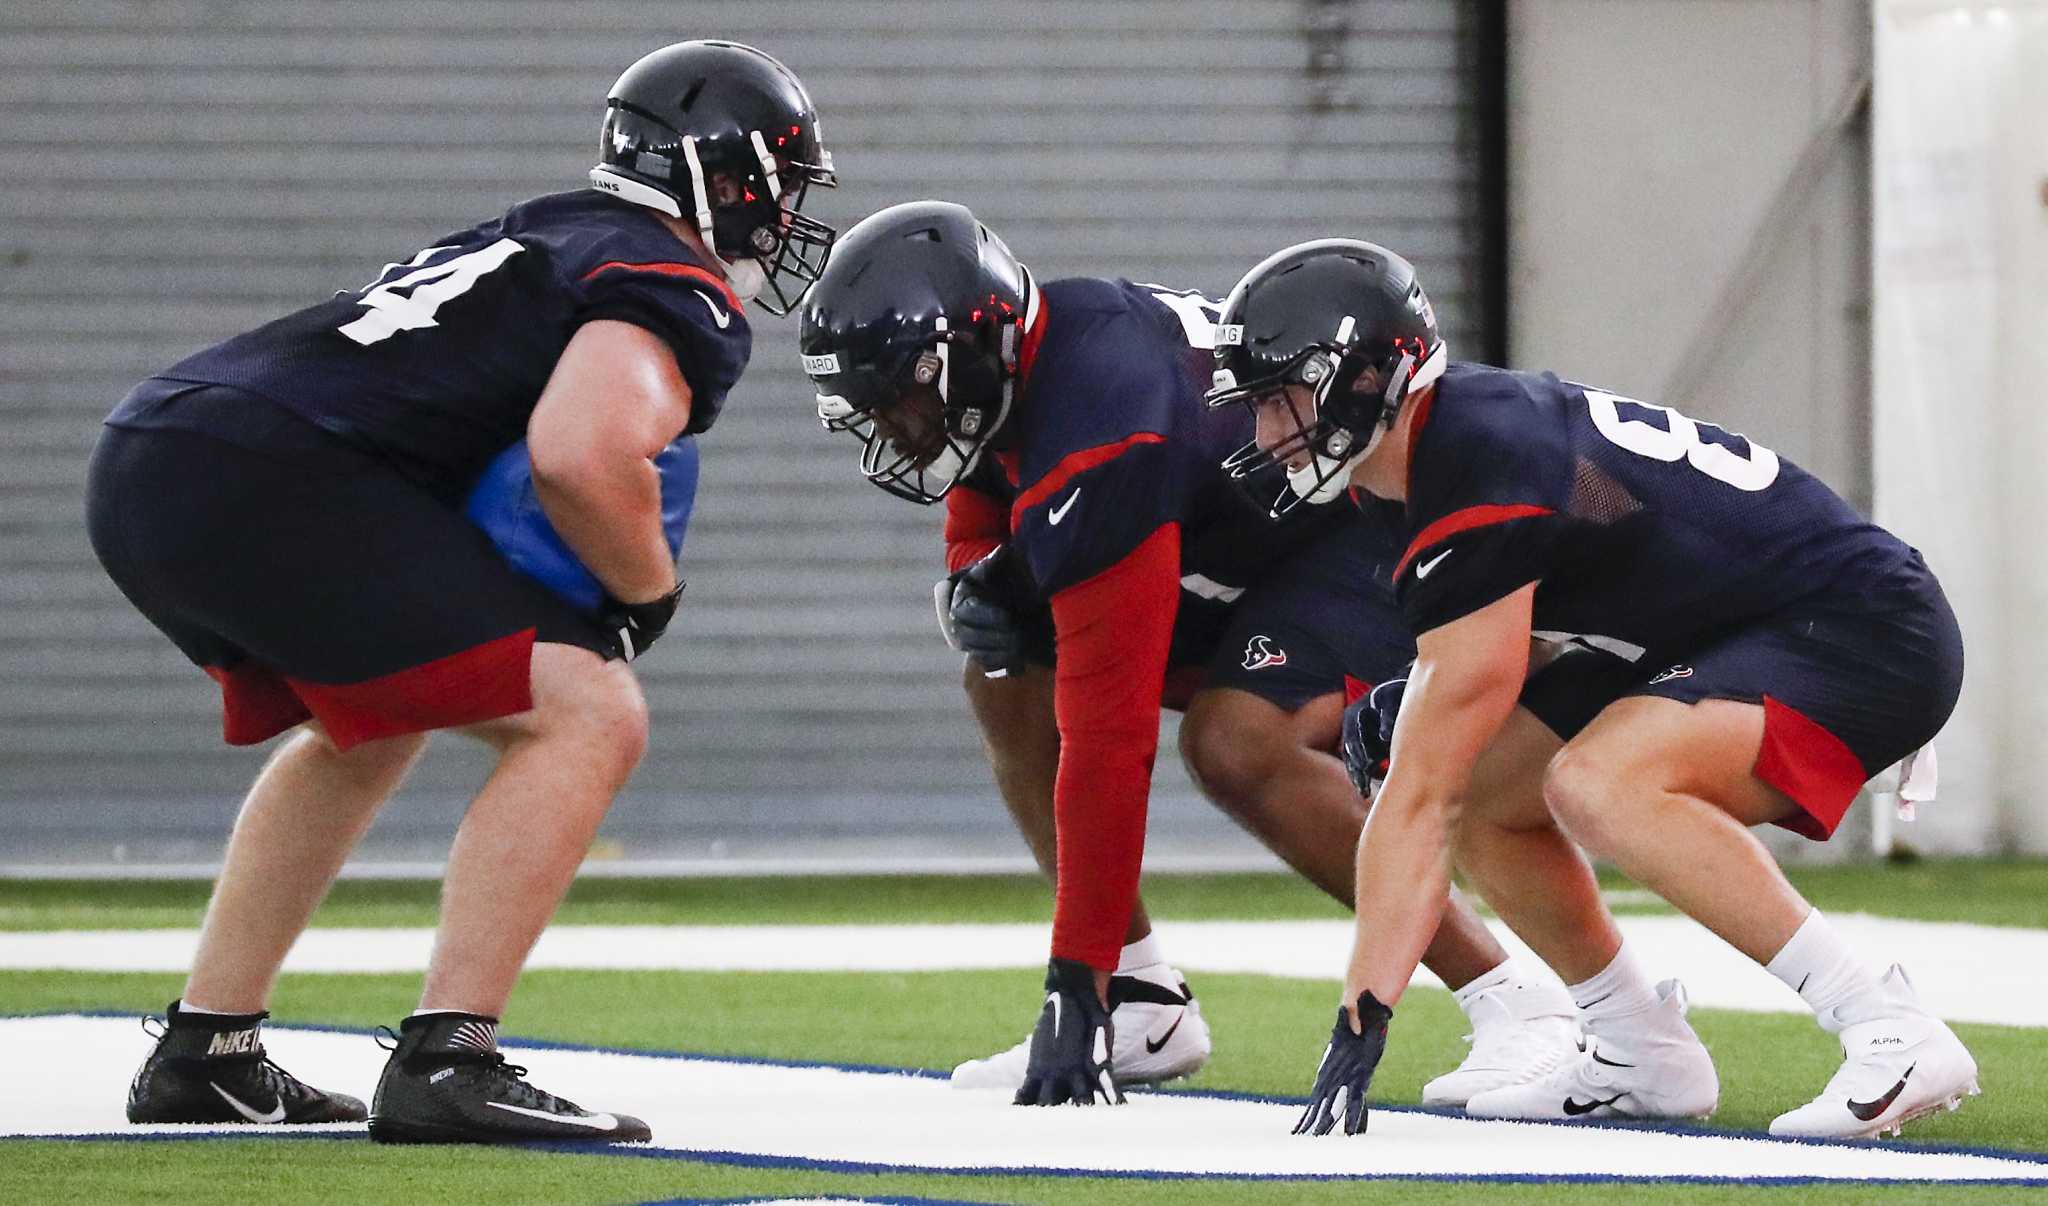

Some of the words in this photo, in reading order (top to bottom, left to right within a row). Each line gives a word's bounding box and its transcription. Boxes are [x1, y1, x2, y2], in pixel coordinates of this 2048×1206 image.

[336, 237, 526, 346] 4
[1582, 388, 1780, 492] 8
[207, 1028, 255, 1055] NIKE
[1870, 1037, 1904, 1046] ALPHA
